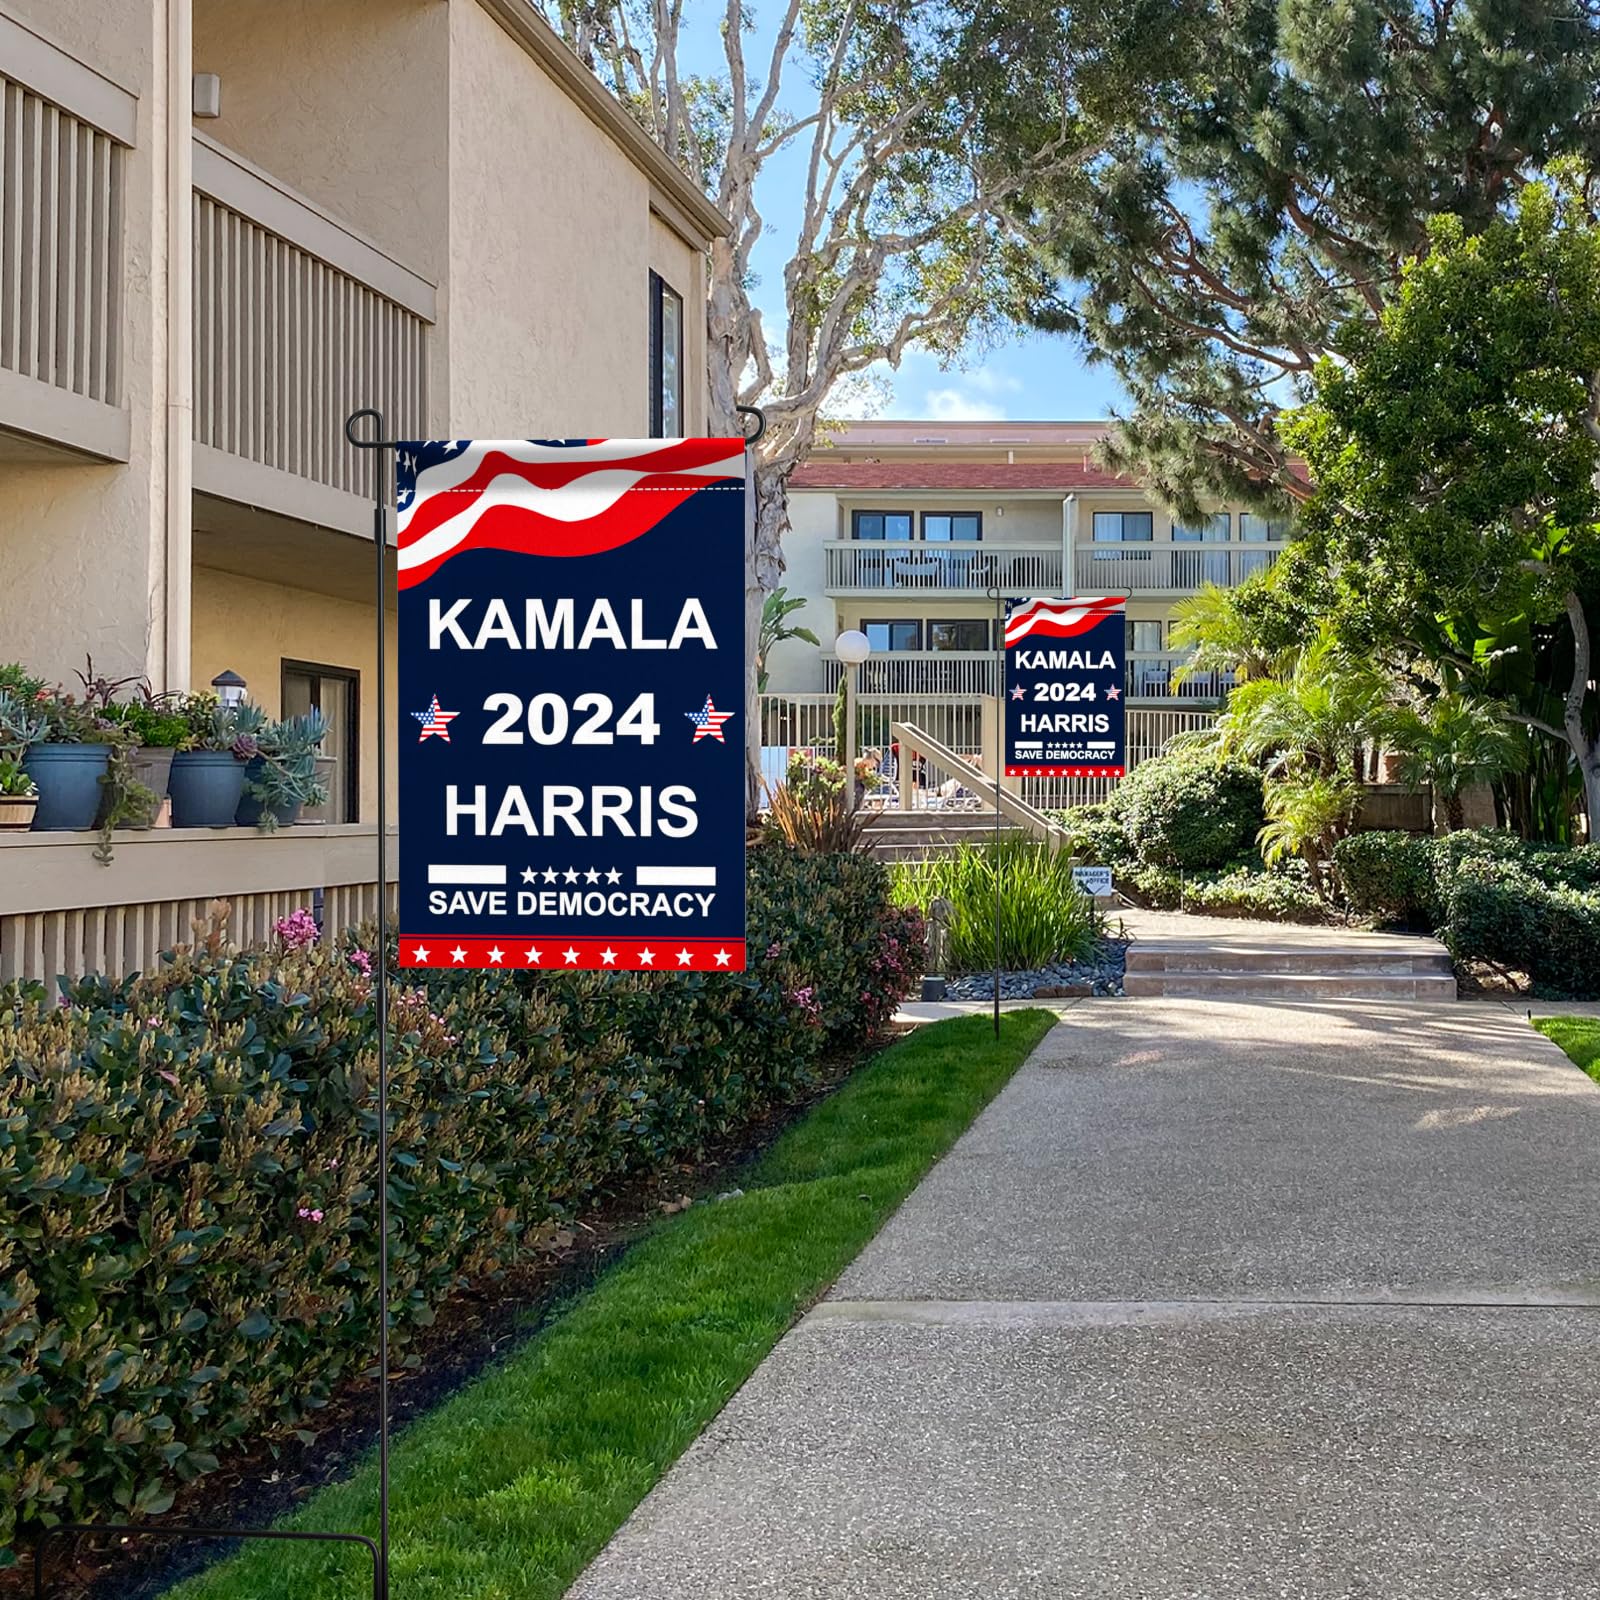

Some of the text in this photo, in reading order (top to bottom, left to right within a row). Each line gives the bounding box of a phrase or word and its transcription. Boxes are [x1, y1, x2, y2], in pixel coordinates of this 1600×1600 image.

[429, 598, 718, 650] KAMALA
[1015, 650, 1117, 670] KAMALA
[1033, 682, 1097, 702] 2024
[482, 692, 661, 746] 2024
[1021, 713, 1110, 733] HARRIS
[1014, 750, 1116, 760] SAVE DEMOCRACY
[446, 784, 699, 838] HARRIS
[428, 890, 716, 917] SAVE DEMOCRACY
